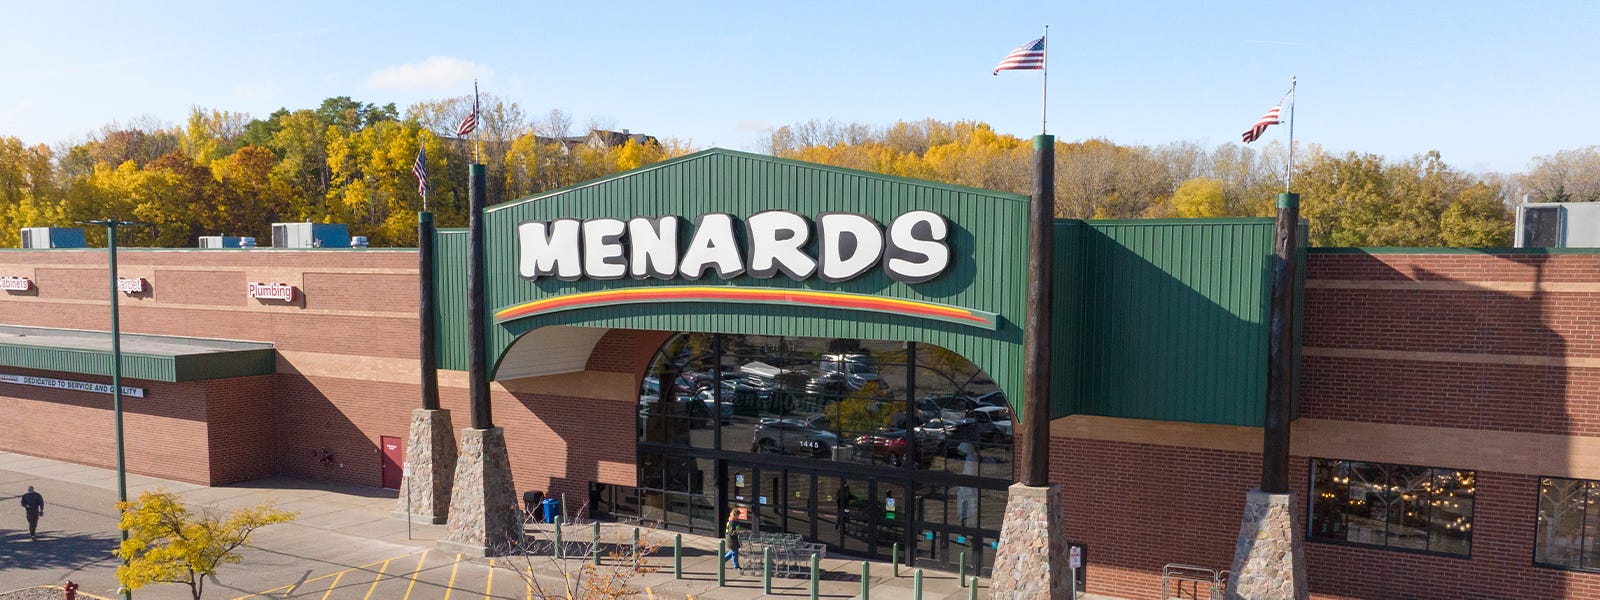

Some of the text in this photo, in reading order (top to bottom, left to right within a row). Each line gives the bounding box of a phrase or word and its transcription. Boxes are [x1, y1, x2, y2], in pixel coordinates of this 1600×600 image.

[518, 209, 950, 281] MENARDS
[118, 279, 141, 292] arpet
[249, 284, 292, 300] Plumbing
[24, 377, 56, 386] DEDICATED
[67, 382, 93, 391] SERVICE
[110, 386, 137, 395] QLITY
[800, 441, 819, 449] 1445
